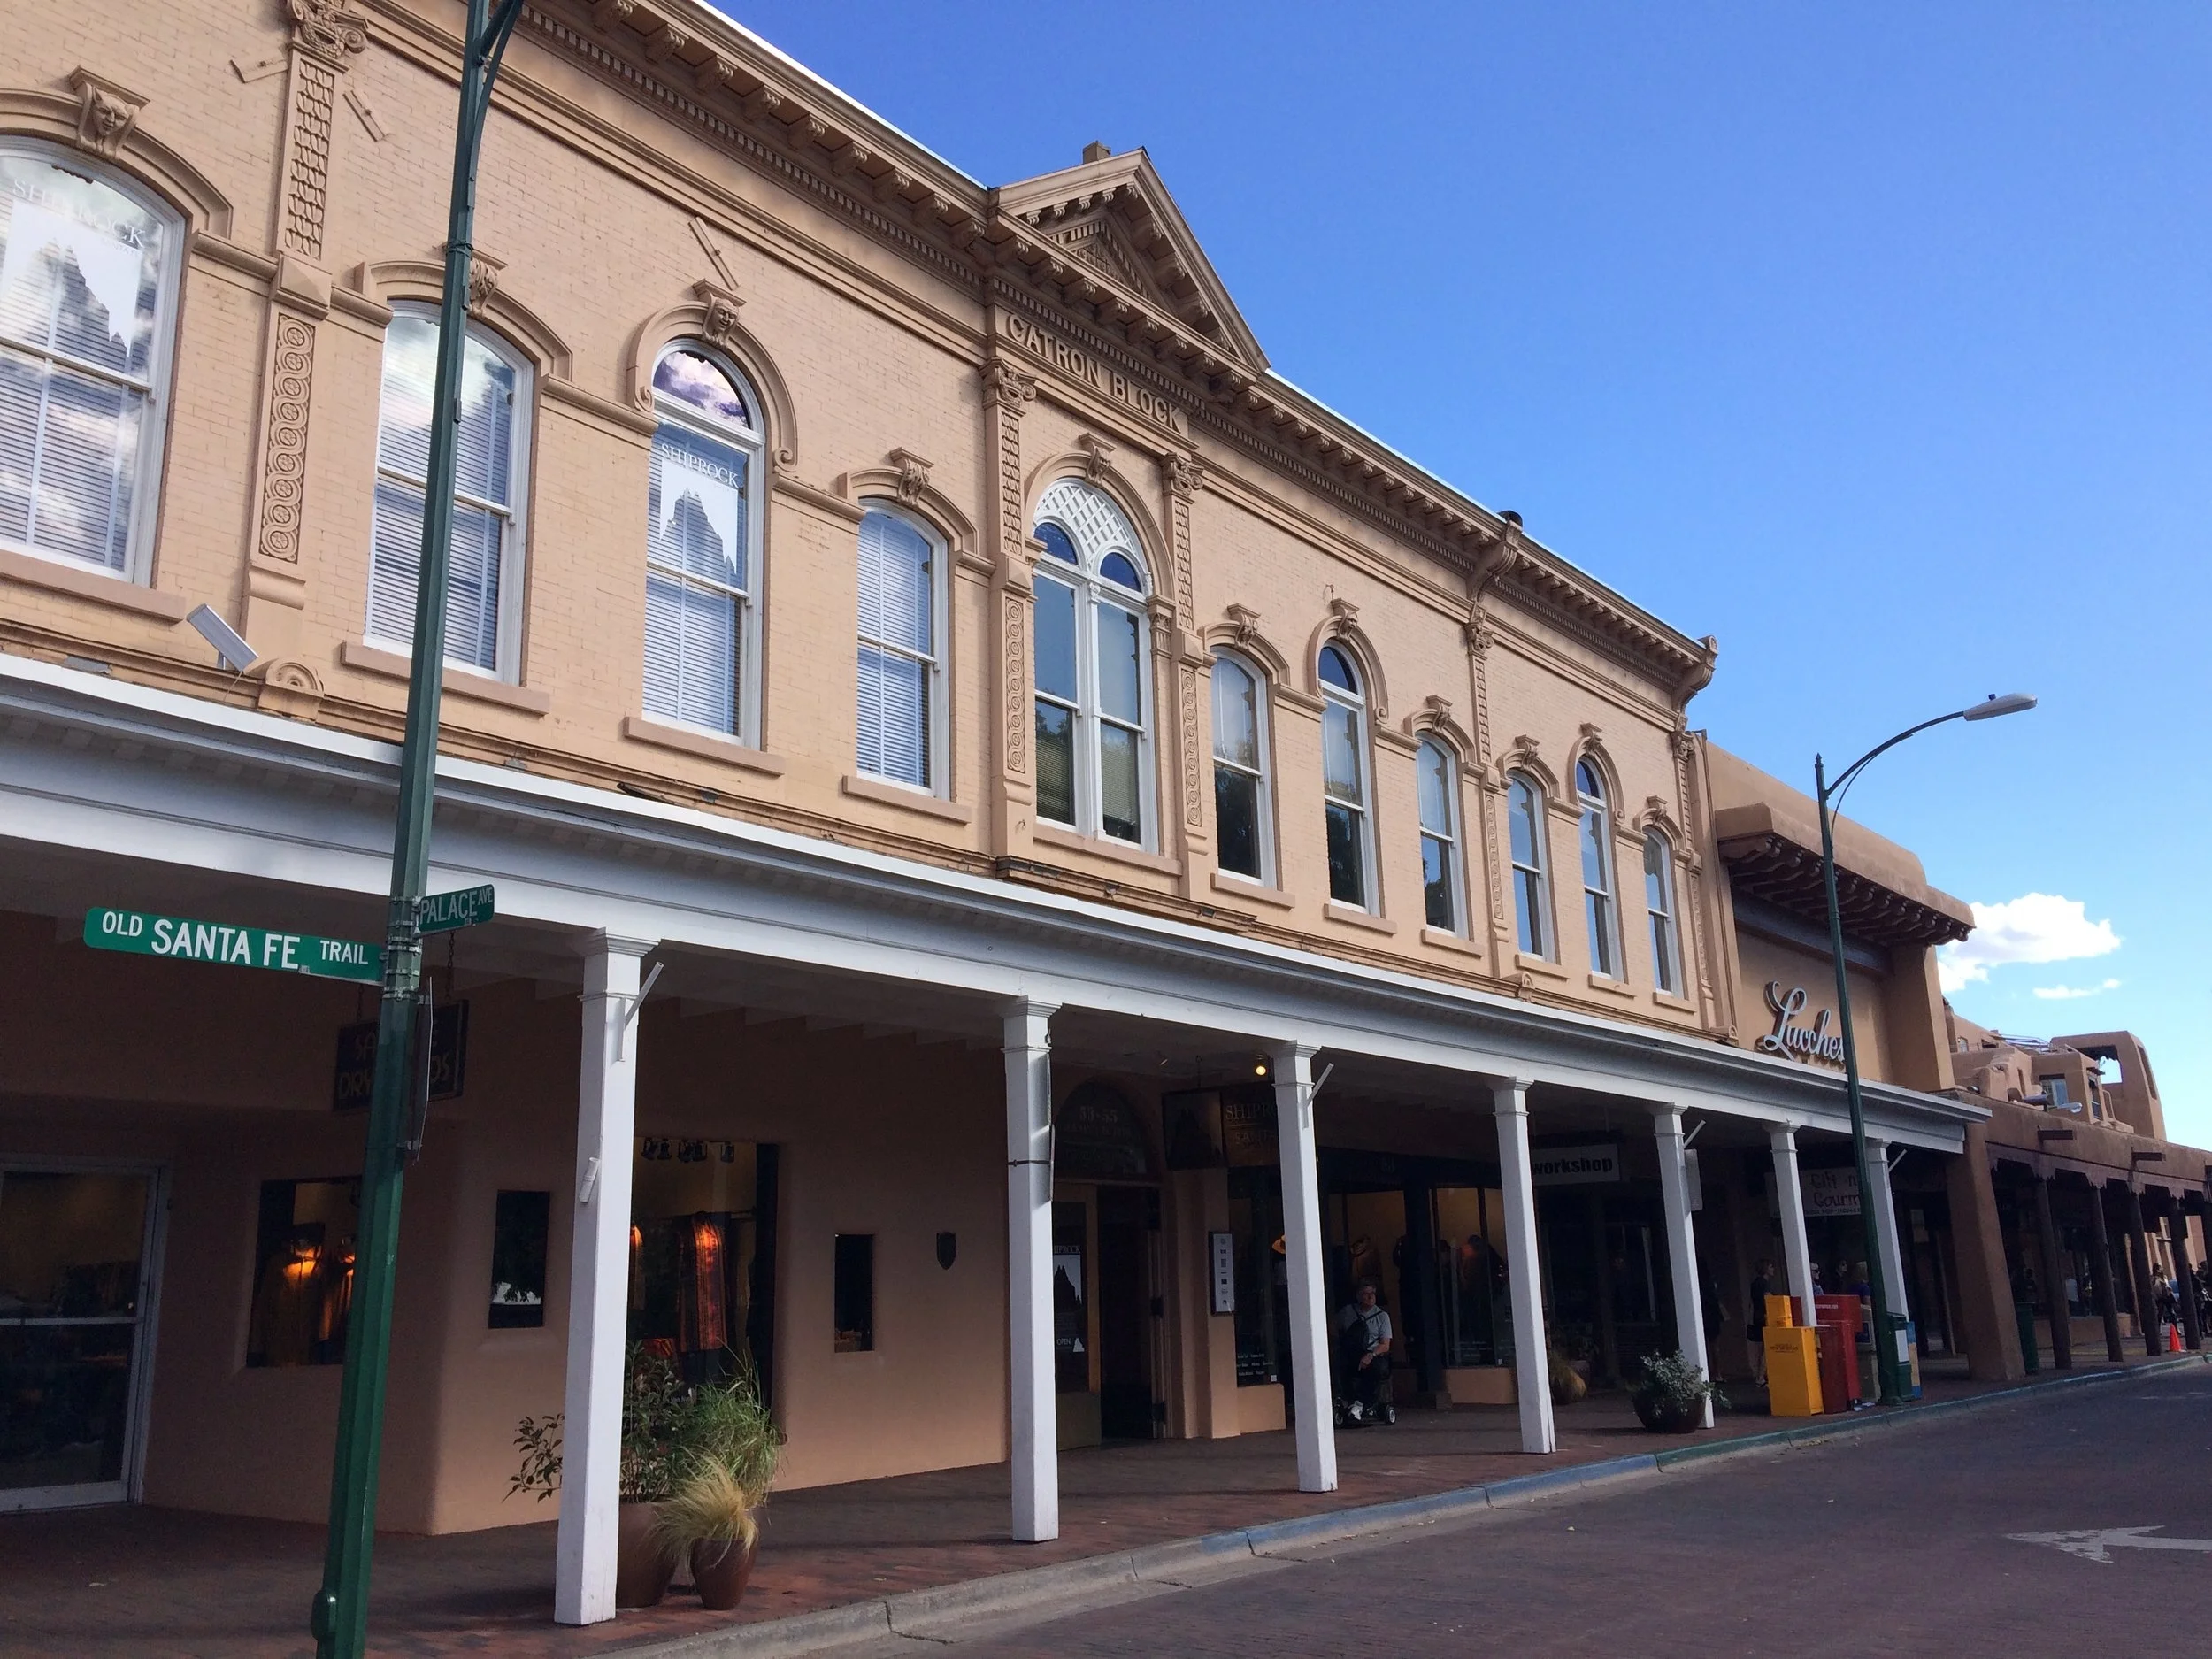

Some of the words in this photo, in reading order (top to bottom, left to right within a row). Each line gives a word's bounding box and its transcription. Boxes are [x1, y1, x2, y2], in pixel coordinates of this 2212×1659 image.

[12, 179, 146, 249] SHIROCK
[1009, 314, 1103, 388] CATRON
[1113, 375, 1182, 433] BLOCK
[661, 443, 739, 488] SHIPROCK
[419, 890, 478, 925] PALACE
[478, 887, 493, 905] AVE
[102, 911, 142, 937] OLD
[151, 918, 250, 964] SANTA
[263, 933, 301, 970] FE
[319, 940, 368, 965] TRAIL
[1763, 980, 1845, 1062] Lucches
[1225, 1102, 1275, 1120] SHIPR
[1814, 1192, 1860, 1208] Gourm
[1054, 1245, 1081, 1254] IPROCK
